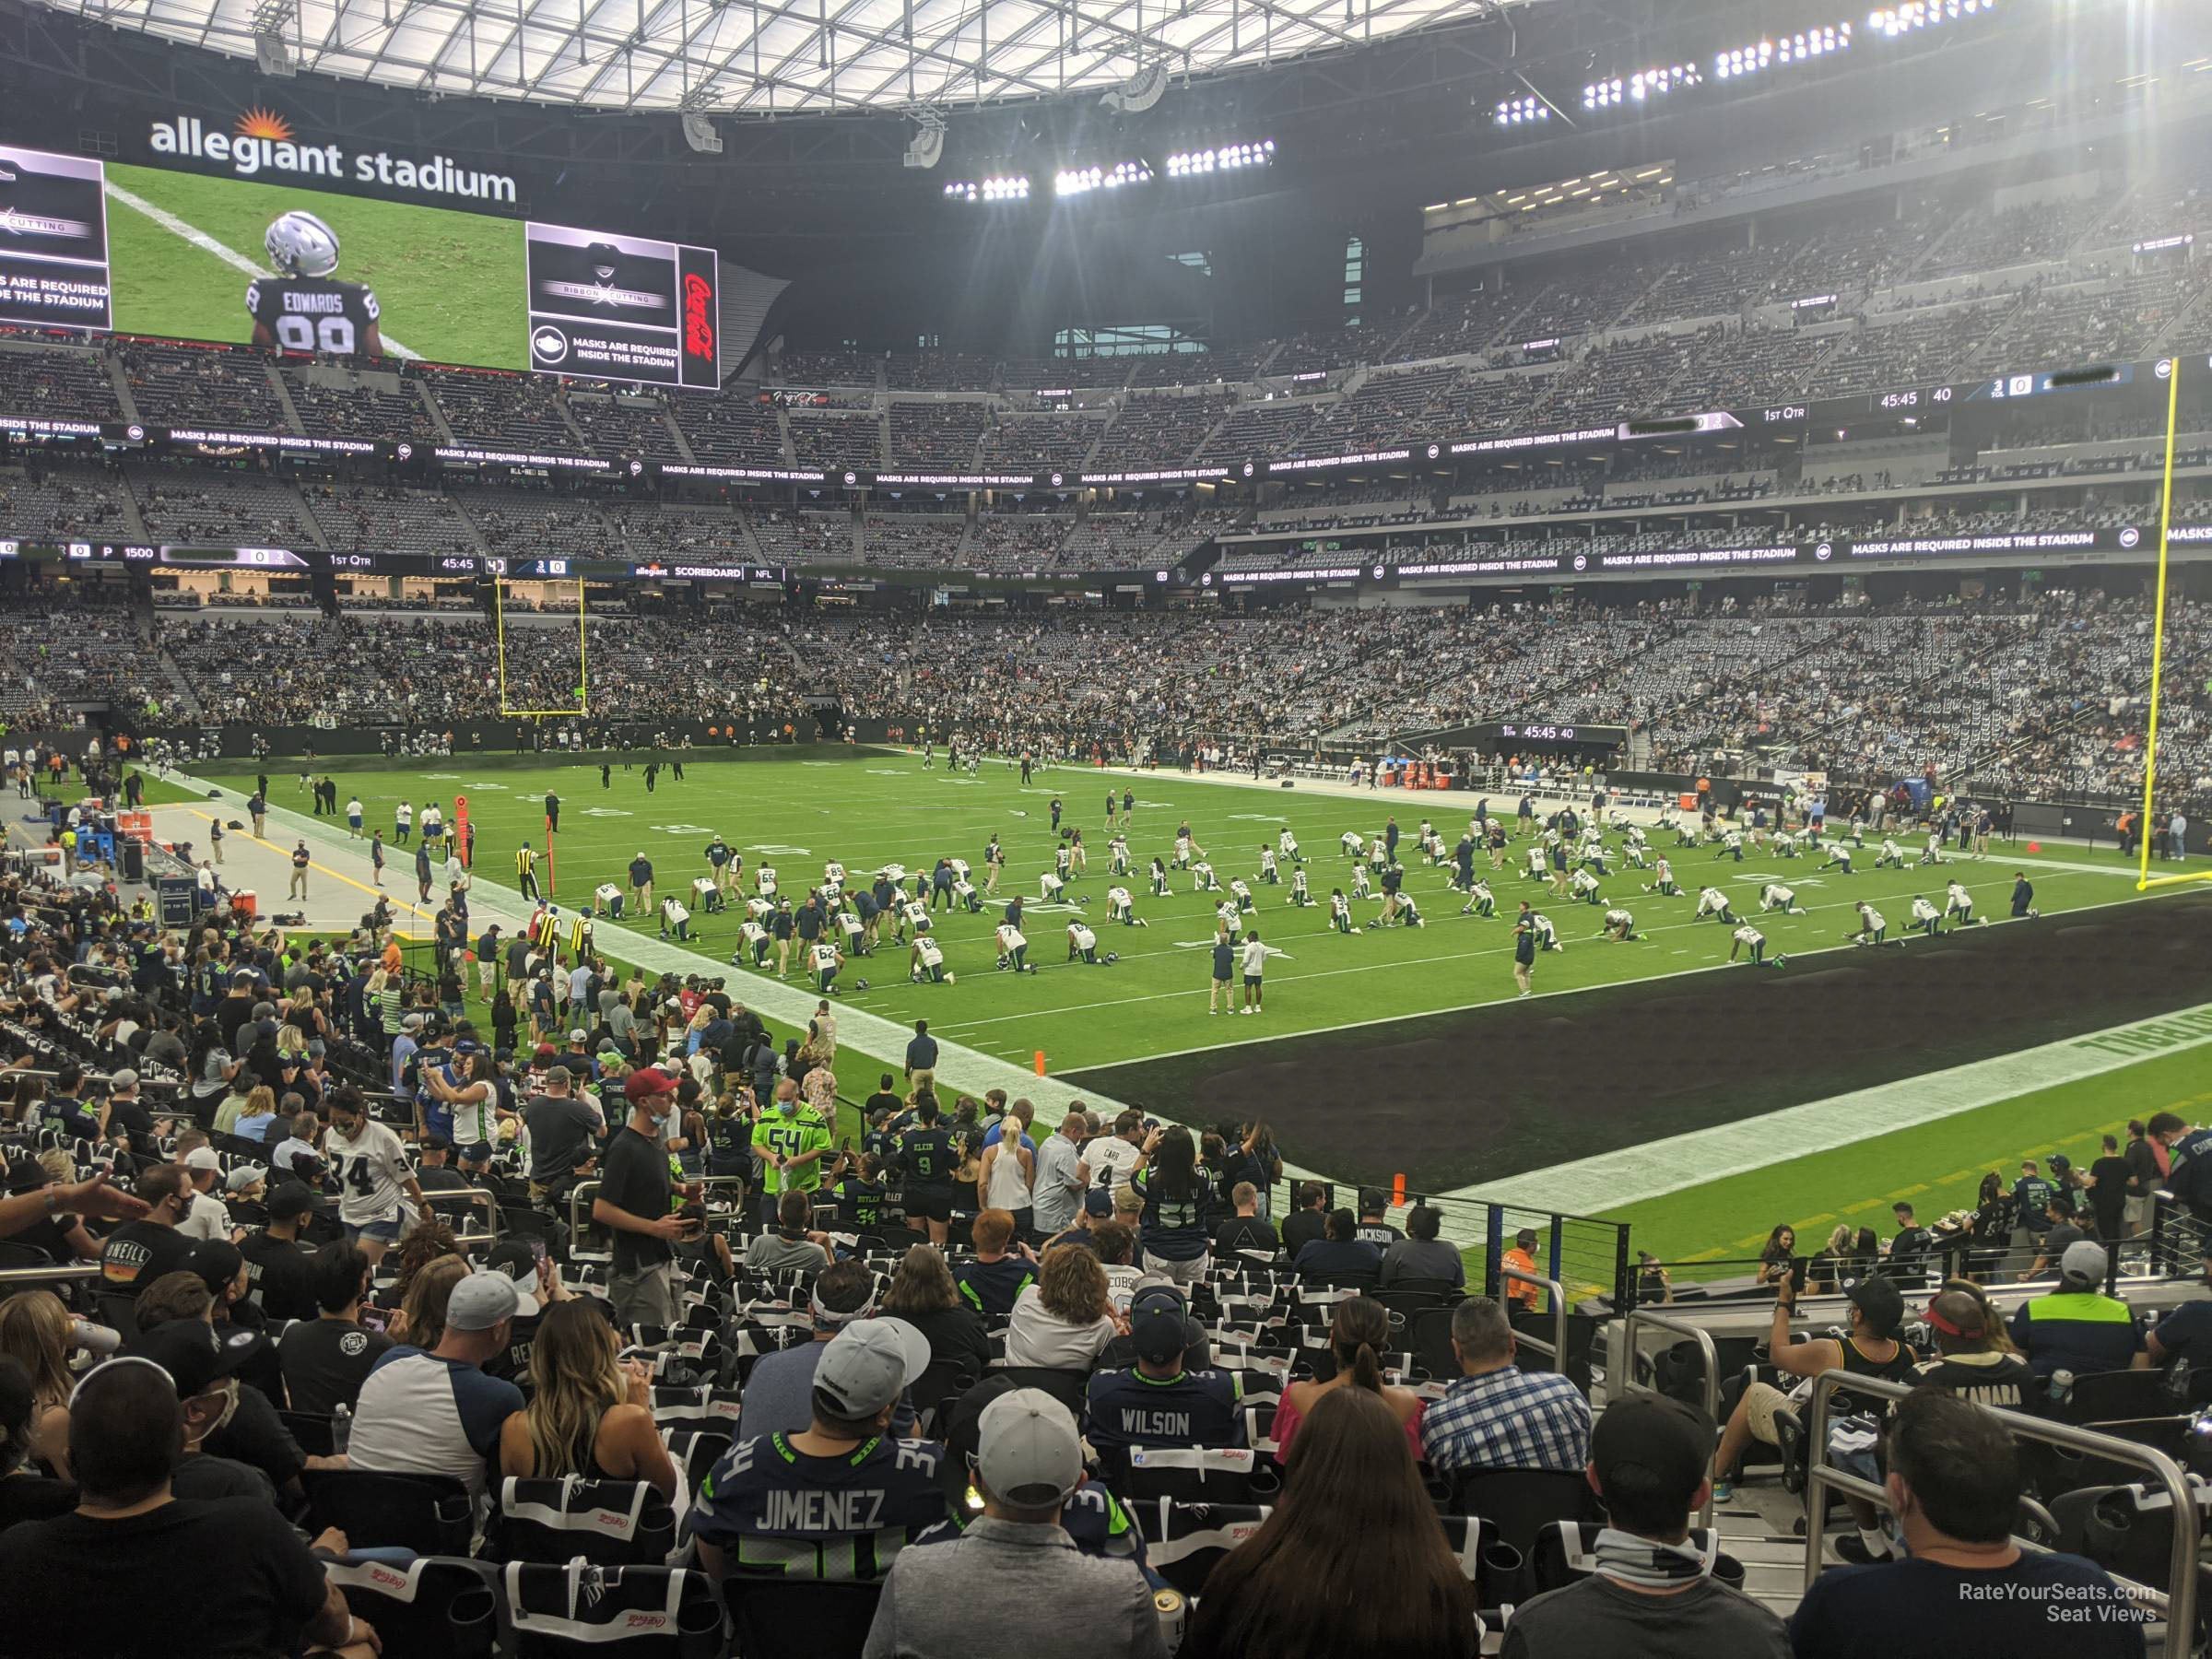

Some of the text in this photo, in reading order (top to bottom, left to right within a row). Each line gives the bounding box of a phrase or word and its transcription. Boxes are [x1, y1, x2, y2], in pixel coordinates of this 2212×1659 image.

[150, 116, 516, 203] allegiant stadium
[9, 218, 65, 231] CUTTING
[10, 277, 38, 289] ARE
[41, 279, 109, 296] REQUIRED
[15, 290, 41, 302] THE
[44, 294, 104, 310] STADIUM
[564, 287, 649, 303] RIBBON CUTTING
[283, 292, 343, 313] EDWARDS
[573, 337, 678, 358] MASKS ARE REQUIRED
[577, 349, 675, 368] INSIDE THE STADIUM
[1994, 380, 2003, 390] 3
[2016, 377, 2026, 392] 0
[1881, 392, 1918, 407] 45:45
[1933, 388, 1951, 402] 40
[29, 421, 50, 429] THE
[53, 423, 100, 433] STADIUM
[171, 429, 373, 452] MASKS ARE REQUIRED INSIDE THE STADIUM
[1452, 428, 1615, 453] MASKS ARE REQUIRED INSIDE THE STADIUM
[436, 448, 465, 458] MASKS
[466, 450, 484, 459] ARE
[486, 452, 527, 463] REQUIRED
[529, 455, 556, 465] INSIDE
[574, 458, 609, 468] STADIUM
[1270, 463, 1291, 471] MASKS
[1307, 458, 1340, 467] REQUIRED
[1341, 455, 1362, 465] INSIDE
[1378, 450, 1409, 460] STADIUM
[663, 465, 688, 474] MASKS
[707, 468, 746, 477] REQUIRED
[747, 470, 772, 478] INSIDE
[790, 472, 824, 480] STADIUM
[1125, 473, 1159, 481] REQUIRED
[1159, 471, 1182, 479] INSIDE
[1197, 468, 1228, 477] STADIUM
[2167, 528, 2212, 540] MASKS
[6, 544, 13, 552] 0
[1853, 533, 2094, 554] MASKS ARE REQUIRED INSIDE THE STADIUM
[76, 547, 84, 555] 0
[103, 547, 154, 558] P 1500
[256, 552, 265, 562] 0
[1604, 547, 1796, 566] MASKS ARE REQUIRED INSIDE THE STADIUM
[330, 555, 347, 565] 1ST
[442, 558, 474, 570] 45:45
[555, 562, 562, 572] 0
[1398, 559, 1558, 574] MASKS ARE REQUIRED INSIDE THE STADIUM
[636, 567, 668, 577] allegiant
[675, 567, 741, 579] SCOREBOARD
[756, 569, 772, 579] NFL
[1260, 571, 1292, 581] REQUIRED
[1293, 571, 1314, 579] INSIDE
[1315, 570, 1328, 578] THE
[1330, 569, 1359, 577] STADIUM
[1524, 726, 1556, 738] 45:45
[1561, 728, 1573, 738] 40
[762, 873, 774, 883] 65
[818, 947, 834, 959] 62
[769, 1127, 802, 1156] 54
[1103, 1148, 1119, 1160] CARR
[919, 1157, 931, 1174] 9
[1098, 1164, 1112, 1186] 4
[1355, 1229, 1394, 1243] JACKSON
[1122, 1408, 1189, 1436] WILSON
[756, 1489, 885, 1531] JIMENEZ
